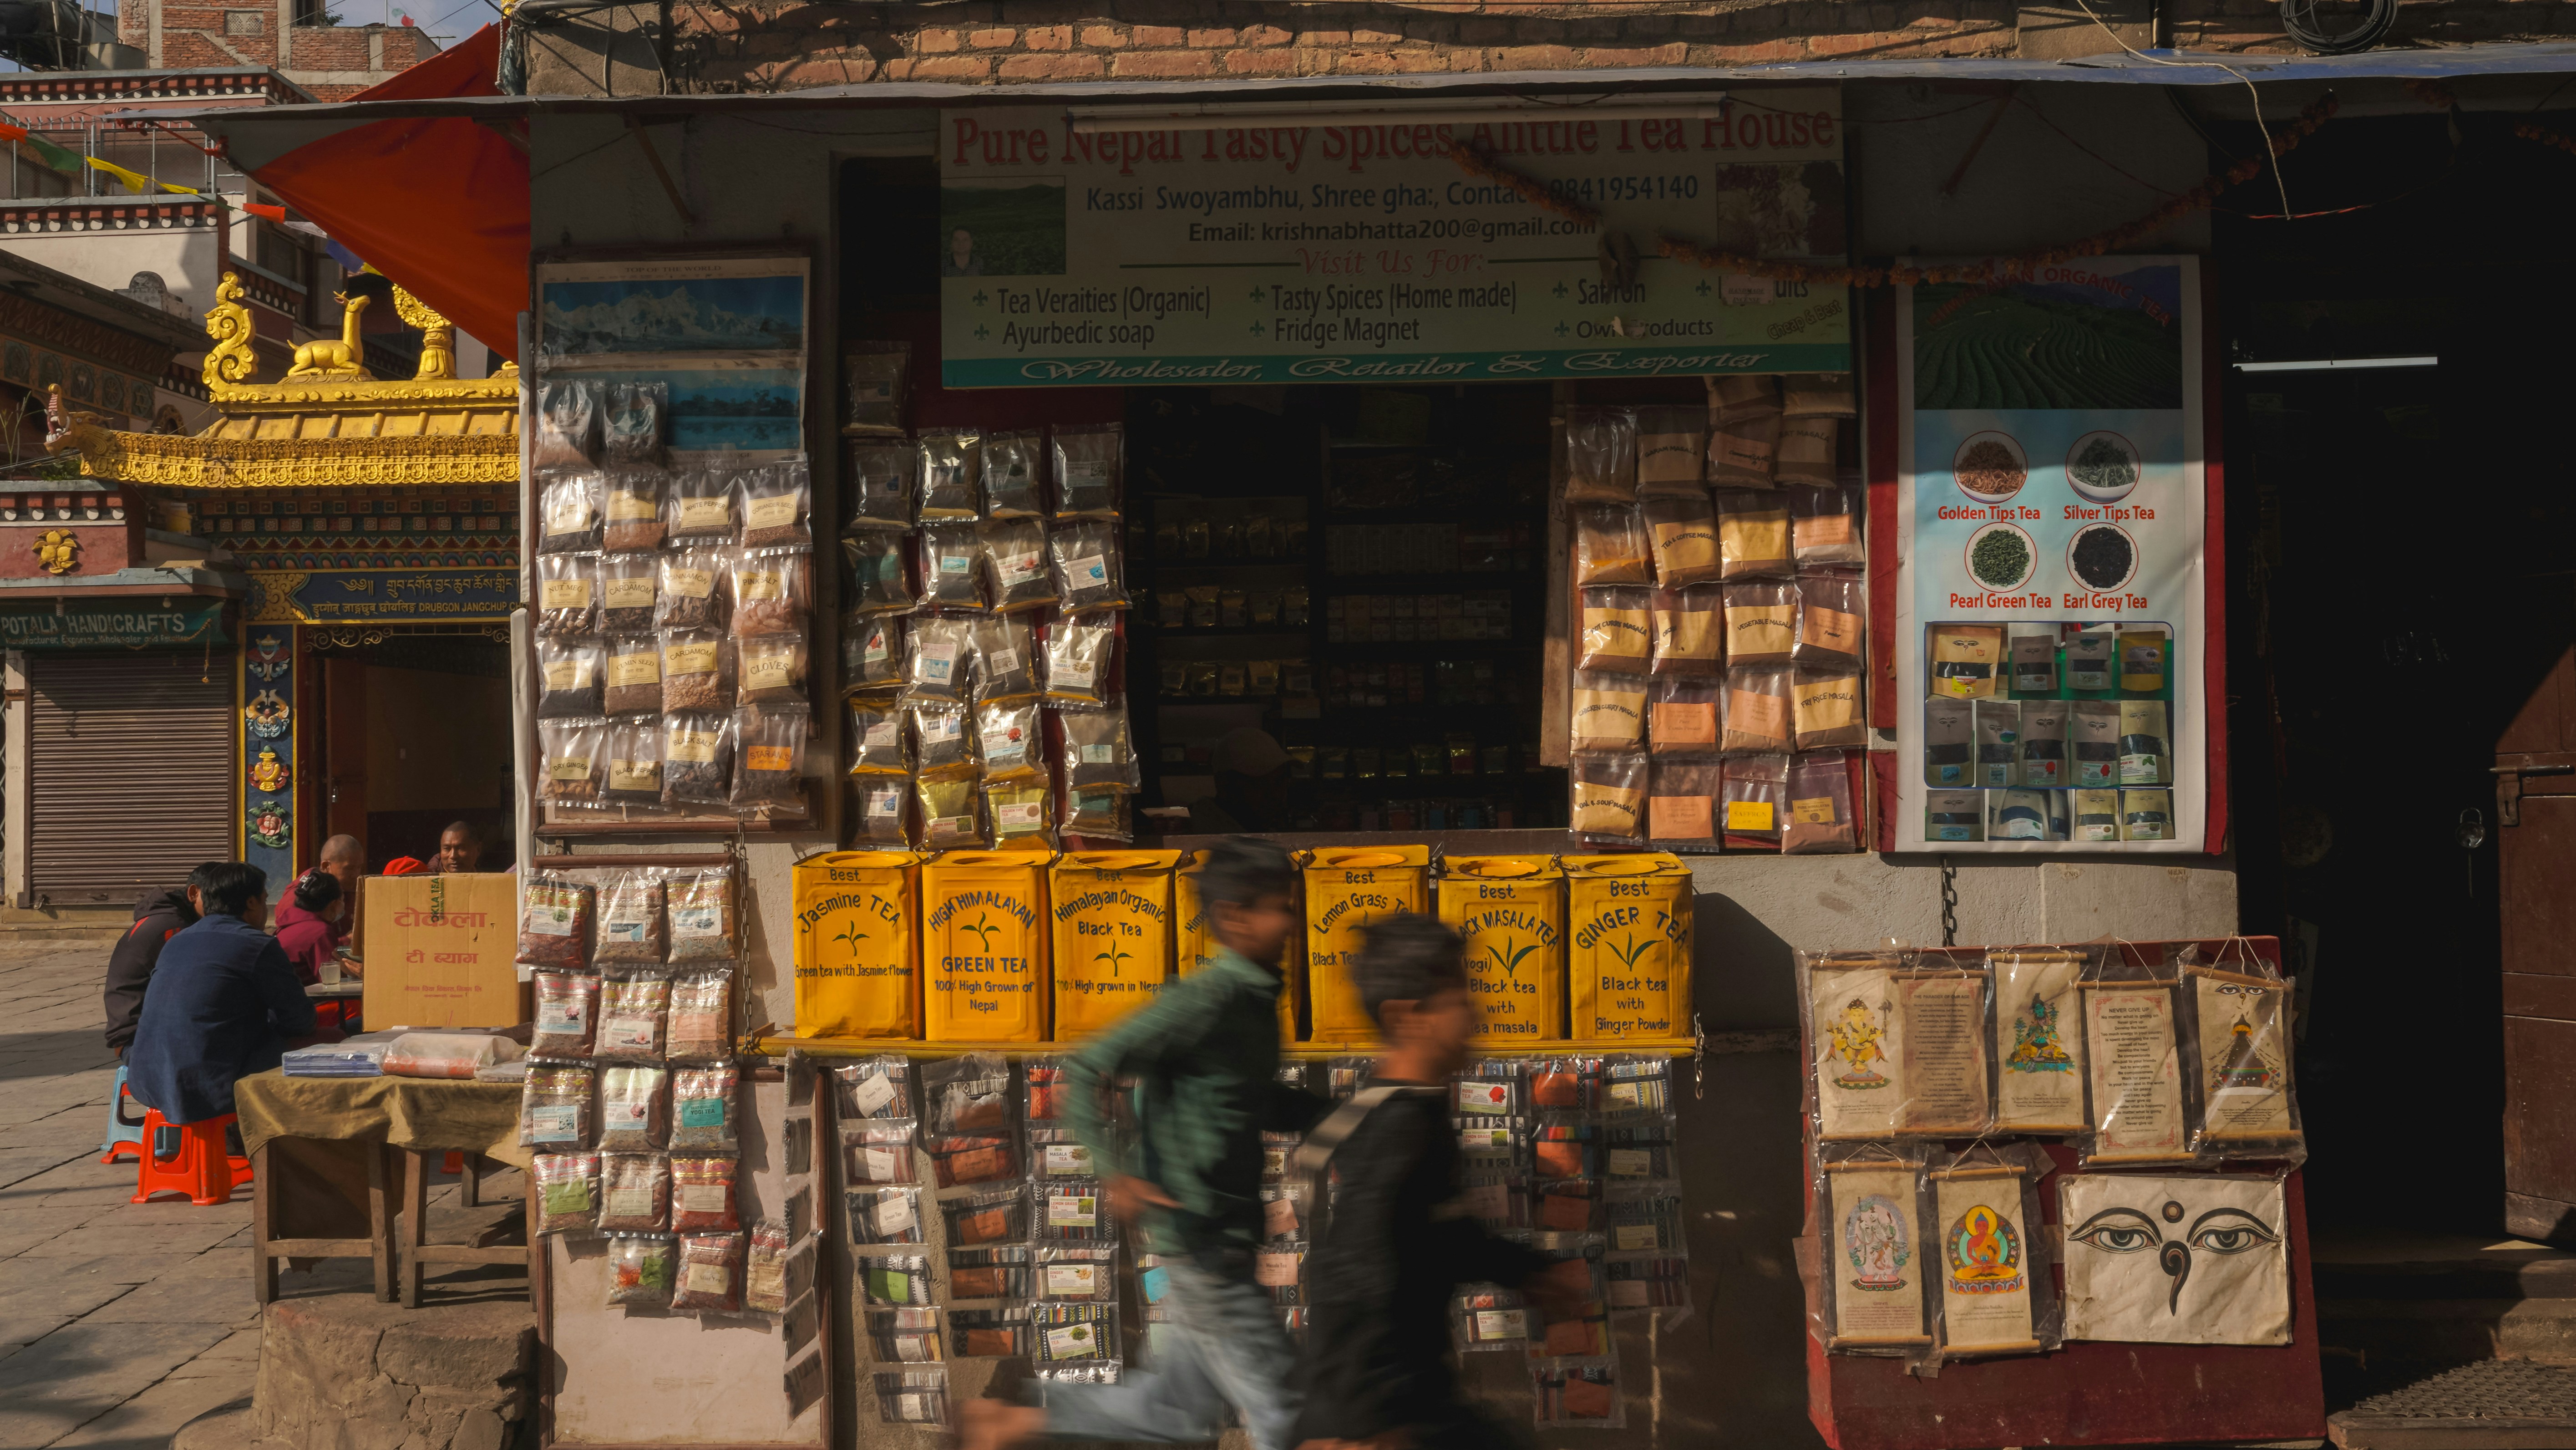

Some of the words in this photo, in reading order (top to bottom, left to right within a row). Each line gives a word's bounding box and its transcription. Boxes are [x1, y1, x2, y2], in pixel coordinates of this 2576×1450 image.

[953, 117, 1048, 165] Pure
[1061, 116, 1183, 176] Nepal
[1321, 108, 1451, 171] Spices
[1700, 101, 1835, 149] House
[1087, 187, 1143, 211] Kassi
[1156, 181, 1304, 216] Swoyambhu,
[1312, 183, 1376, 208] Shree
[1549, 175, 1699, 201] 9841954140
[1189, 223, 1255, 243] Email:
[1262, 217, 1596, 243] krishnabhatta200@gmail.com
[1295, 247, 1365, 275] Visit
[1376, 249, 1414, 274] Us
[1421, 247, 1484, 278] For:
[997, 289, 1030, 315] Tea
[1035, 287, 1117, 314] Veraities
[1123, 286, 1211, 320] (Organic)
[1271, 285, 1321, 318] Tasty
[1326, 284, 1384, 318] Spices
[1389, 283, 1453, 317] (Home
[1457, 281, 1517, 314] made)
[2044, 268, 2135, 300] ORGANIC
[2139, 295, 2174, 328] TEA
[1767, 317, 1805, 340] Cheap
[1804, 310, 1817, 324] &
[1813, 300, 1843, 321] Best
[1002, 321, 1104, 352] Ayurbedic
[1109, 323, 1155, 351] soap
[1274, 317, 1339, 349] Fridge
[1343, 317, 1420, 348] Magnet
[1020, 360, 1263, 382] Wholesaler,
[1288, 356, 1476, 377] Retailor
[1487, 354, 1547, 374] &
[1563, 351, 1771, 376] Exporter
[1796, 431, 1829, 443] MASALA
[1645, 447, 1668, 457] GARAM
[1670, 445, 1699, 456] MASALA
[685, 503, 702, 512] WHITE
[704, 501, 726, 509] PEPPER
[751, 502, 780, 515] CORIANDER
[780, 502, 794, 510] SEED
[1937, 505, 1986, 520] Golden
[1990, 505, 2015, 524] Tips
[2017, 506, 2041, 520] Tea
[2064, 505, 2100, 520] Silver
[2102, 506, 2130, 524] Tips
[2132, 506, 2155, 520] Tea
[743, 577, 759, 586] PINK
[761, 575, 778, 585] SALT
[549, 585, 564, 594] NUT
[609, 584, 652, 595] CARDAMOM
[419, 602, 460, 613] DRUBGON
[461, 601, 508, 612] JANGCHUP
[1950, 593, 1983, 609] Pearl
[1987, 593, 2027, 609] Green
[2029, 594, 2052, 608] Tea
[2063, 593, 2089, 609] Earl
[2092, 593, 2122, 613] Grey
[2125, 594, 2148, 609] Tea
[1, 615, 59, 635] POTALA
[66, 613, 186, 634] HANDICRAFTS
[1737, 618, 1769, 631] VEGETABLE
[1770, 619, 1792, 630] MASALA
[669, 648, 712, 661] CARDAMOM
[616, 659, 634, 671] CUMIN
[636, 658, 653, 667] SEED
[750, 661, 791, 675] CLOVES
[1801, 697, 1812, 708] FRY
[1828, 692, 1854, 701] MASALA
[1578, 704, 1601, 716] CHICKEN
[1619, 706, 1638, 720] MASALA
[673, 737, 695, 747] BLACK
[696, 738, 713, 748] SALT
[750, 750, 770, 761] STAR
[553, 762, 565, 771] DRY
[566, 762, 589, 772] GINGER
[615, 767, 634, 776] BLACK
[636, 767, 659, 778] PEPPER
[830, 869, 862, 882] Best
[1346, 871, 1376, 885] Best
[1479, 884, 1516, 900] Best
[1609, 880, 1650, 897] Best
[797, 892, 862, 934] Jasmine
[869, 894, 902, 928] TEA
[928, 899, 958, 932] HIGH
[955, 890, 1037, 930] HIMALAYAN
[1054, 889, 1118, 923] Himalayan
[1120, 888, 1167, 923] Organic
[1313, 899, 1350, 935] Lemon
[1350, 893, 1388, 909] Grass
[1078, 921, 1114, 936] Black
[1119, 921, 1142, 937] Tea
[1482, 909, 1535, 933] MASALA
[1534, 919, 1560, 953] TEA
[1576, 906, 1641, 950] GINGER
[1656, 911, 1688, 946] TEA
[406, 949, 426, 964] टी
[434, 953, 479, 964] ब्याग
[942, 956, 995, 973] GREEN
[999, 956, 1029, 973] TEA
[795, 965, 818, 978] Green
[819, 966, 833, 977] tea
[834, 963, 856, 977] with
[857, 963, 886, 977] Jasmine
[887, 963, 914, 977] flower
[958, 978, 982, 993] High
[984, 981, 1019, 992] Grown
[1021, 981, 1035, 993] of
[1074, 978, 1095, 995] High
[1096, 981, 1125, 995] grown
[1127, 979, 1136, 992] in
[1470, 979, 1507, 994] Black
[1513, 979, 1536, 994] tea
[1601, 976, 1642, 996] Black
[1646, 976, 1667, 996] tea
[969, 998, 999, 1014] Nepal
[1493, 1021, 1537, 1038] masala
[1595, 1016, 1635, 1039] Ginger
[1638, 1016, 1671, 1035] Powder
[1050, 1333, 1066, 1342] HERBAL
